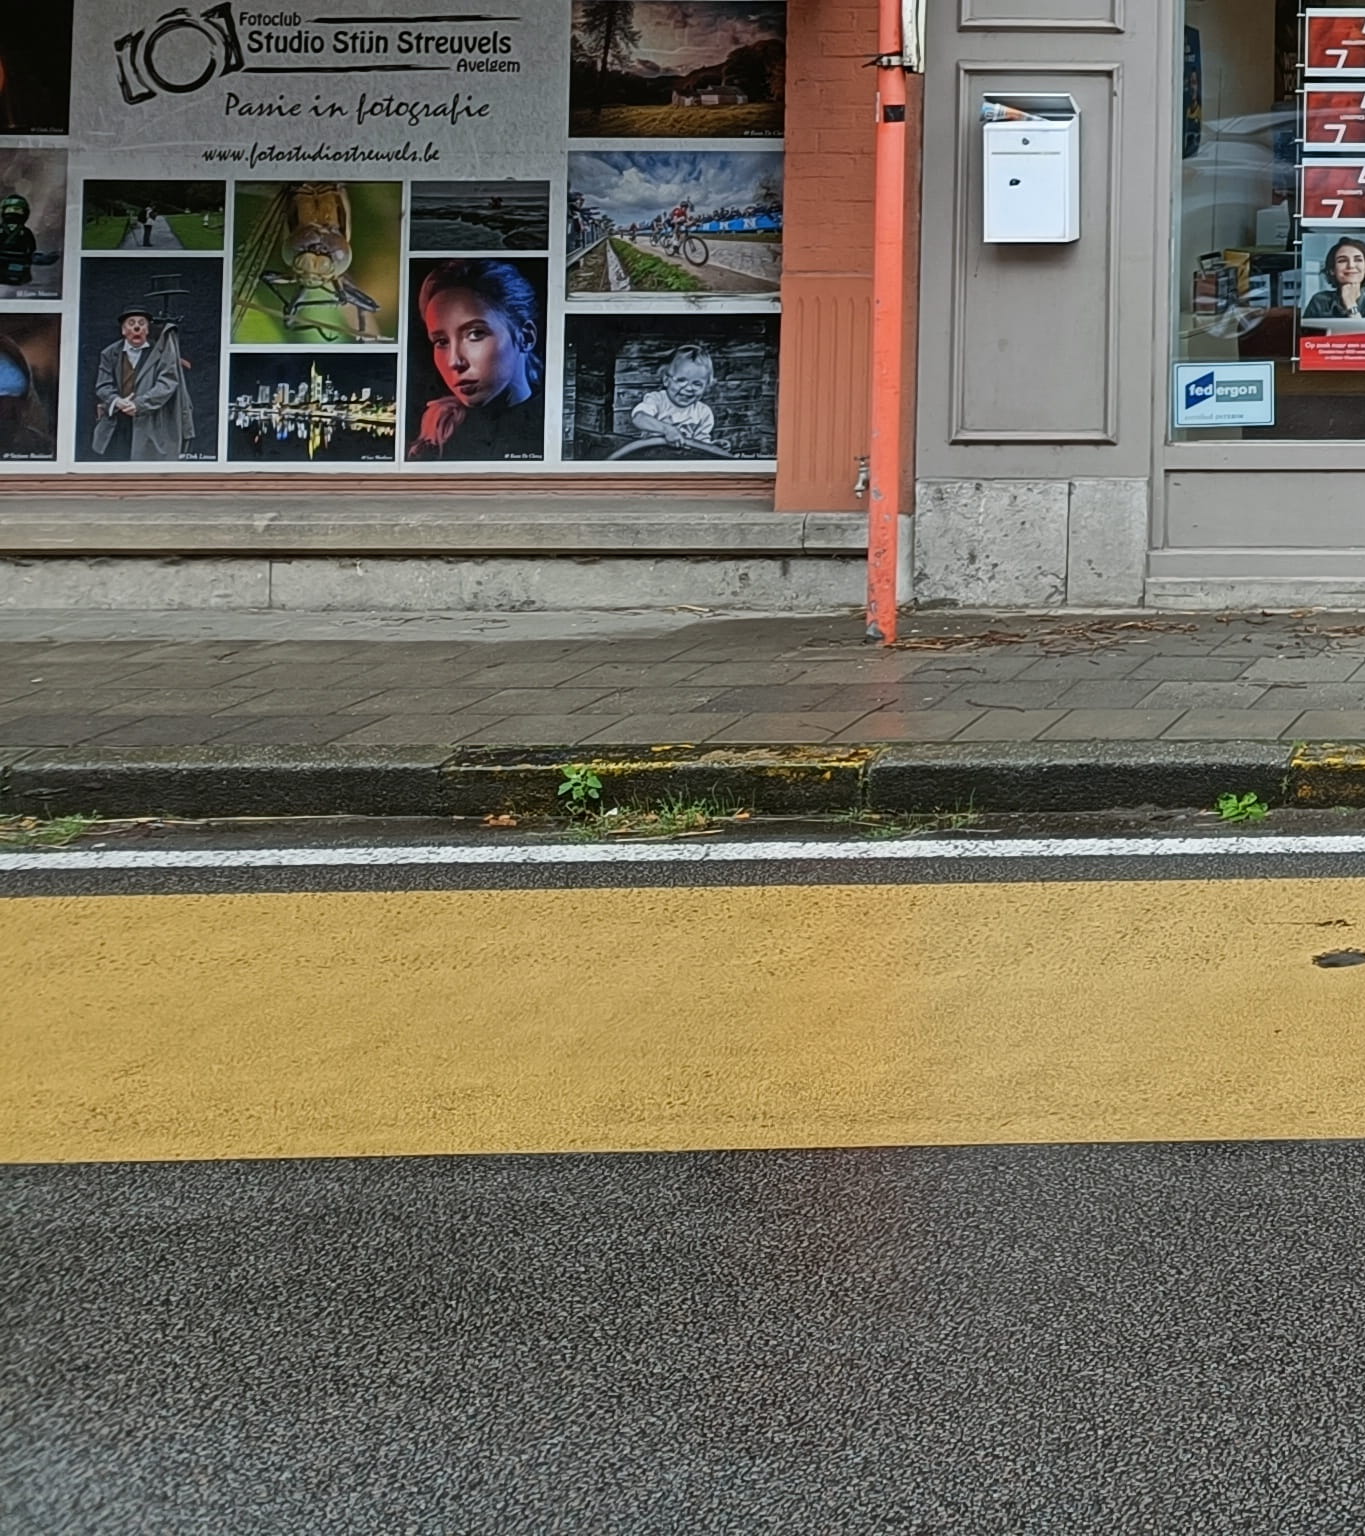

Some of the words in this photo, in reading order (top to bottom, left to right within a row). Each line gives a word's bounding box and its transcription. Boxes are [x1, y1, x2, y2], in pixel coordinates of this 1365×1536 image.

[239, 11, 301, 27] Fotoclub
[247, 30, 324, 54] Studio
[332, 30, 388, 54] Stijn
[397, 30, 511, 54] Streuvels
[456, 58, 520, 73] Avelgem
[225, 92, 301, 116] Passie
[309, 94, 347, 116] in
[356, 92, 490, 126] fotografie
[201, 141, 440, 169] www.fotostudiostreuvels.be
[1188, 383, 1258, 398] federgon
